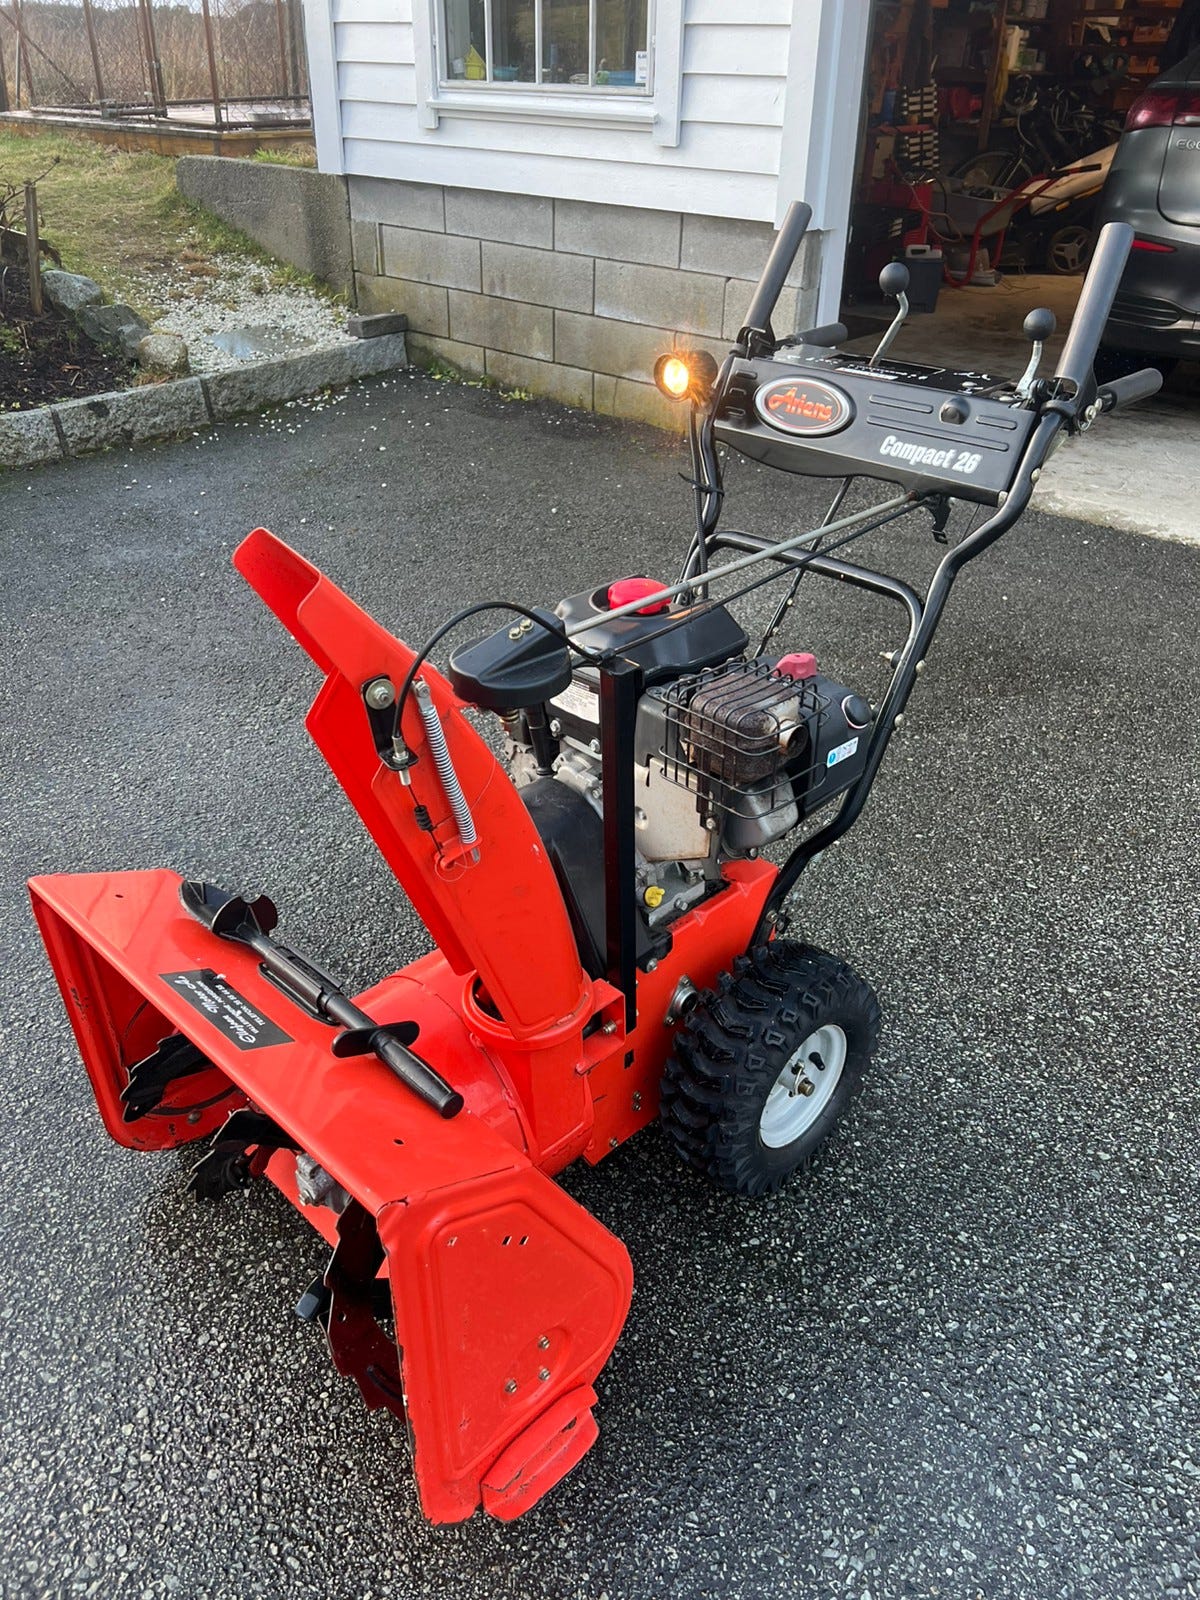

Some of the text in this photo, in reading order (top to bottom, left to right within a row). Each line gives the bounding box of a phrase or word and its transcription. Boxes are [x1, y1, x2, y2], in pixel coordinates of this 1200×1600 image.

[768, 387, 833, 421] Ariens
[880, 435, 983, 474] Compact 26
